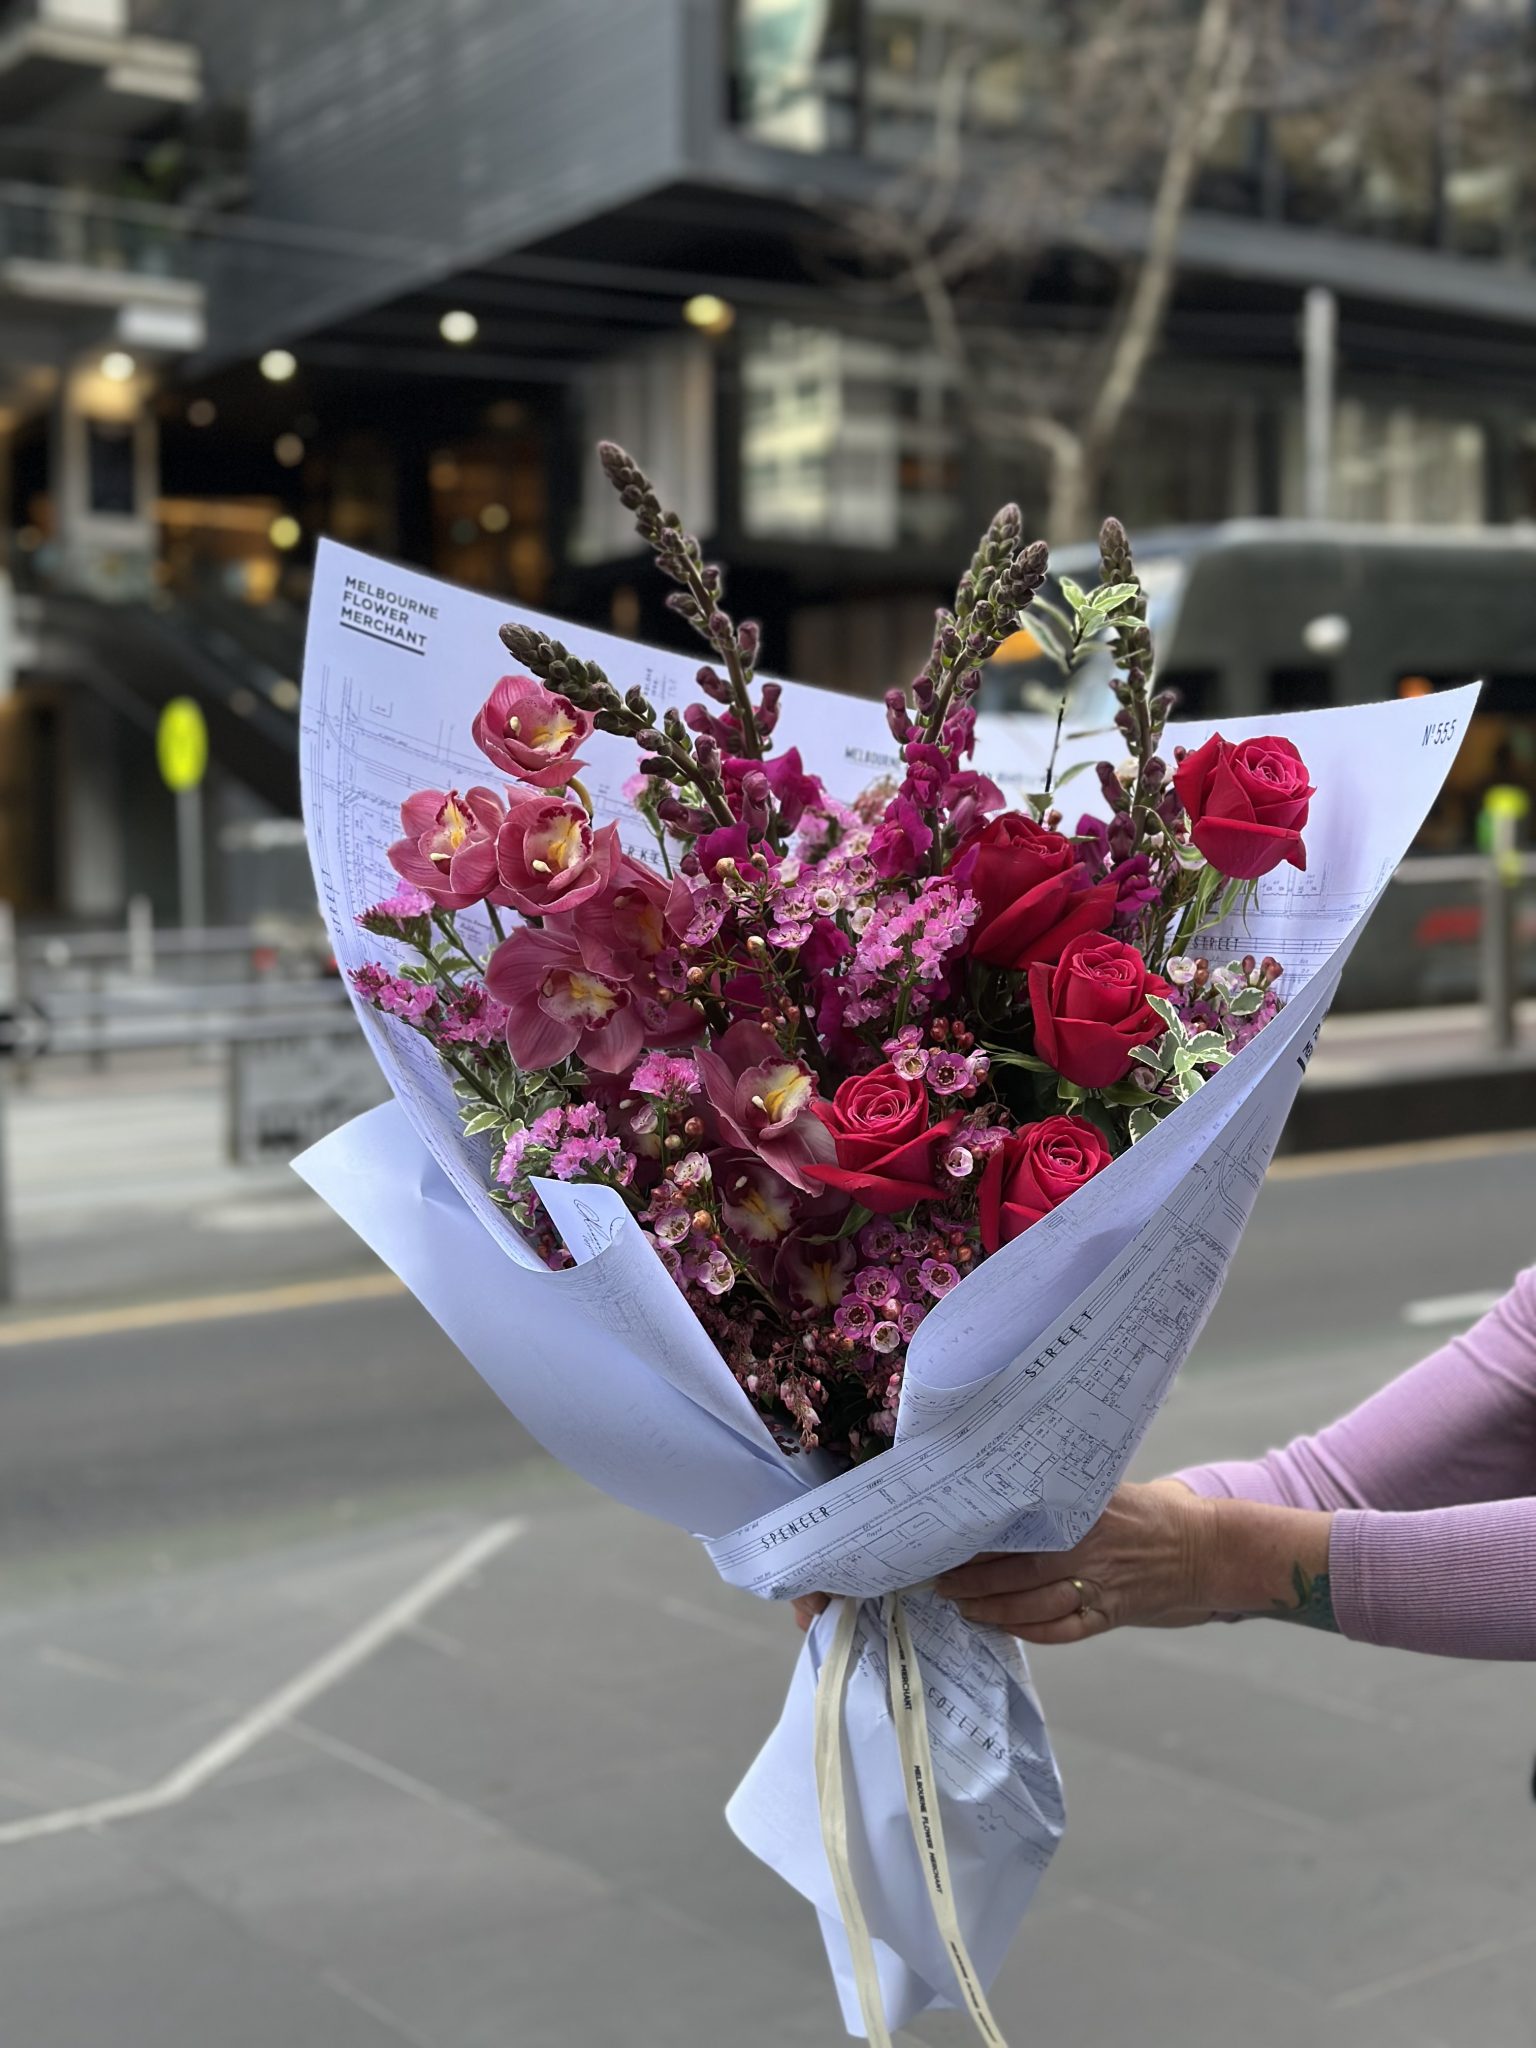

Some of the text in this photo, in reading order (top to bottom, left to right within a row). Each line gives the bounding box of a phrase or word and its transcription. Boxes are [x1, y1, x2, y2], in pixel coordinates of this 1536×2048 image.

[342, 590, 410, 626] FLOWER
[344, 575, 440, 621] MELBOURNE
[340, 605, 428, 648] MERCHANT
[1192, 936, 1240, 952] STREET
[1024, 1309, 1093, 1379] STREET
[760, 1505, 831, 1550] SPENCER
[900, 1663, 913, 1711] MERCHANT
[927, 1686, 1006, 1761] COLLINS
[913, 1764, 928, 1813] MELBOURNE
[921, 1815, 934, 1850] FLOWER
